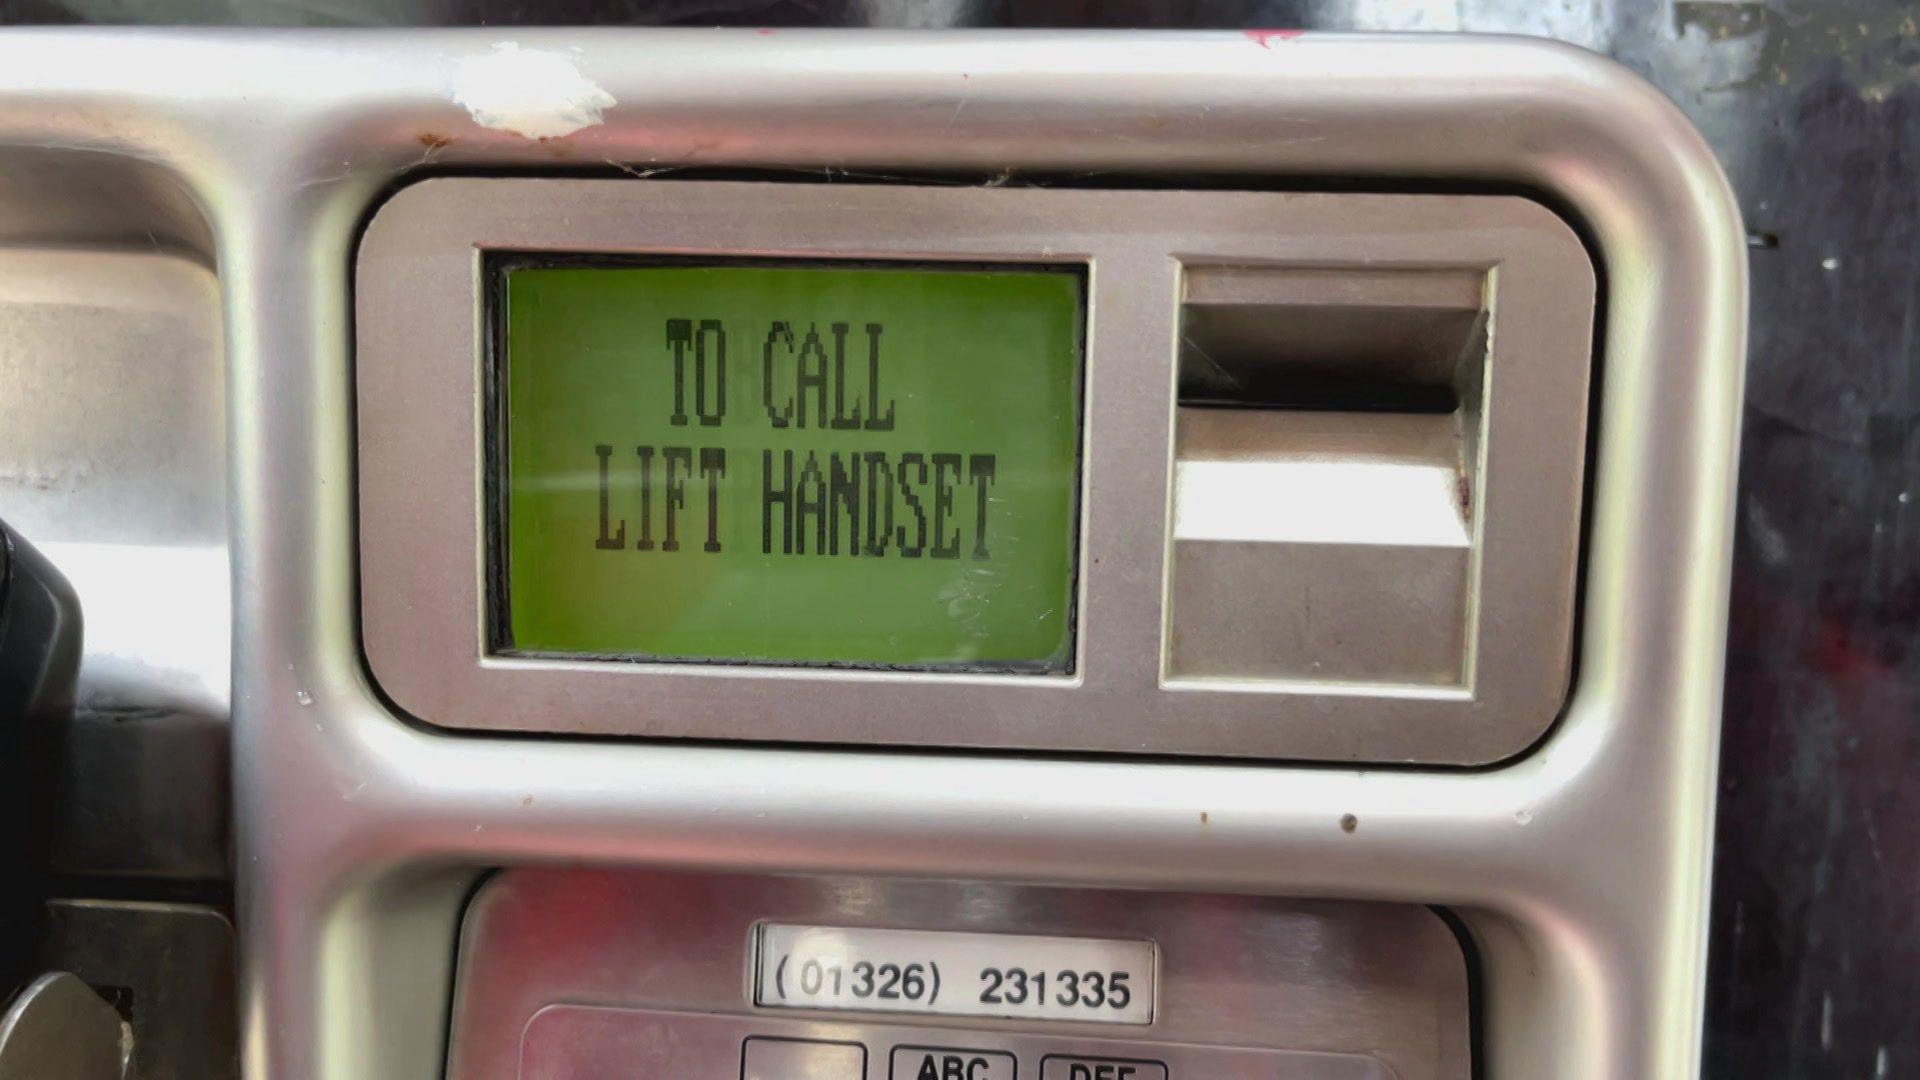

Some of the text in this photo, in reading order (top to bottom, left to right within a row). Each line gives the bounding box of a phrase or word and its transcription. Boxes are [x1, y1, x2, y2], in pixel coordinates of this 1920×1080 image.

[666, 319, 895, 431] TO CALL
[595, 445, 996, 561] LIFT HANDSET
[775, 955, 1132, 1010] (01326) 231335
[917, 1054, 991, 1080] ABC
